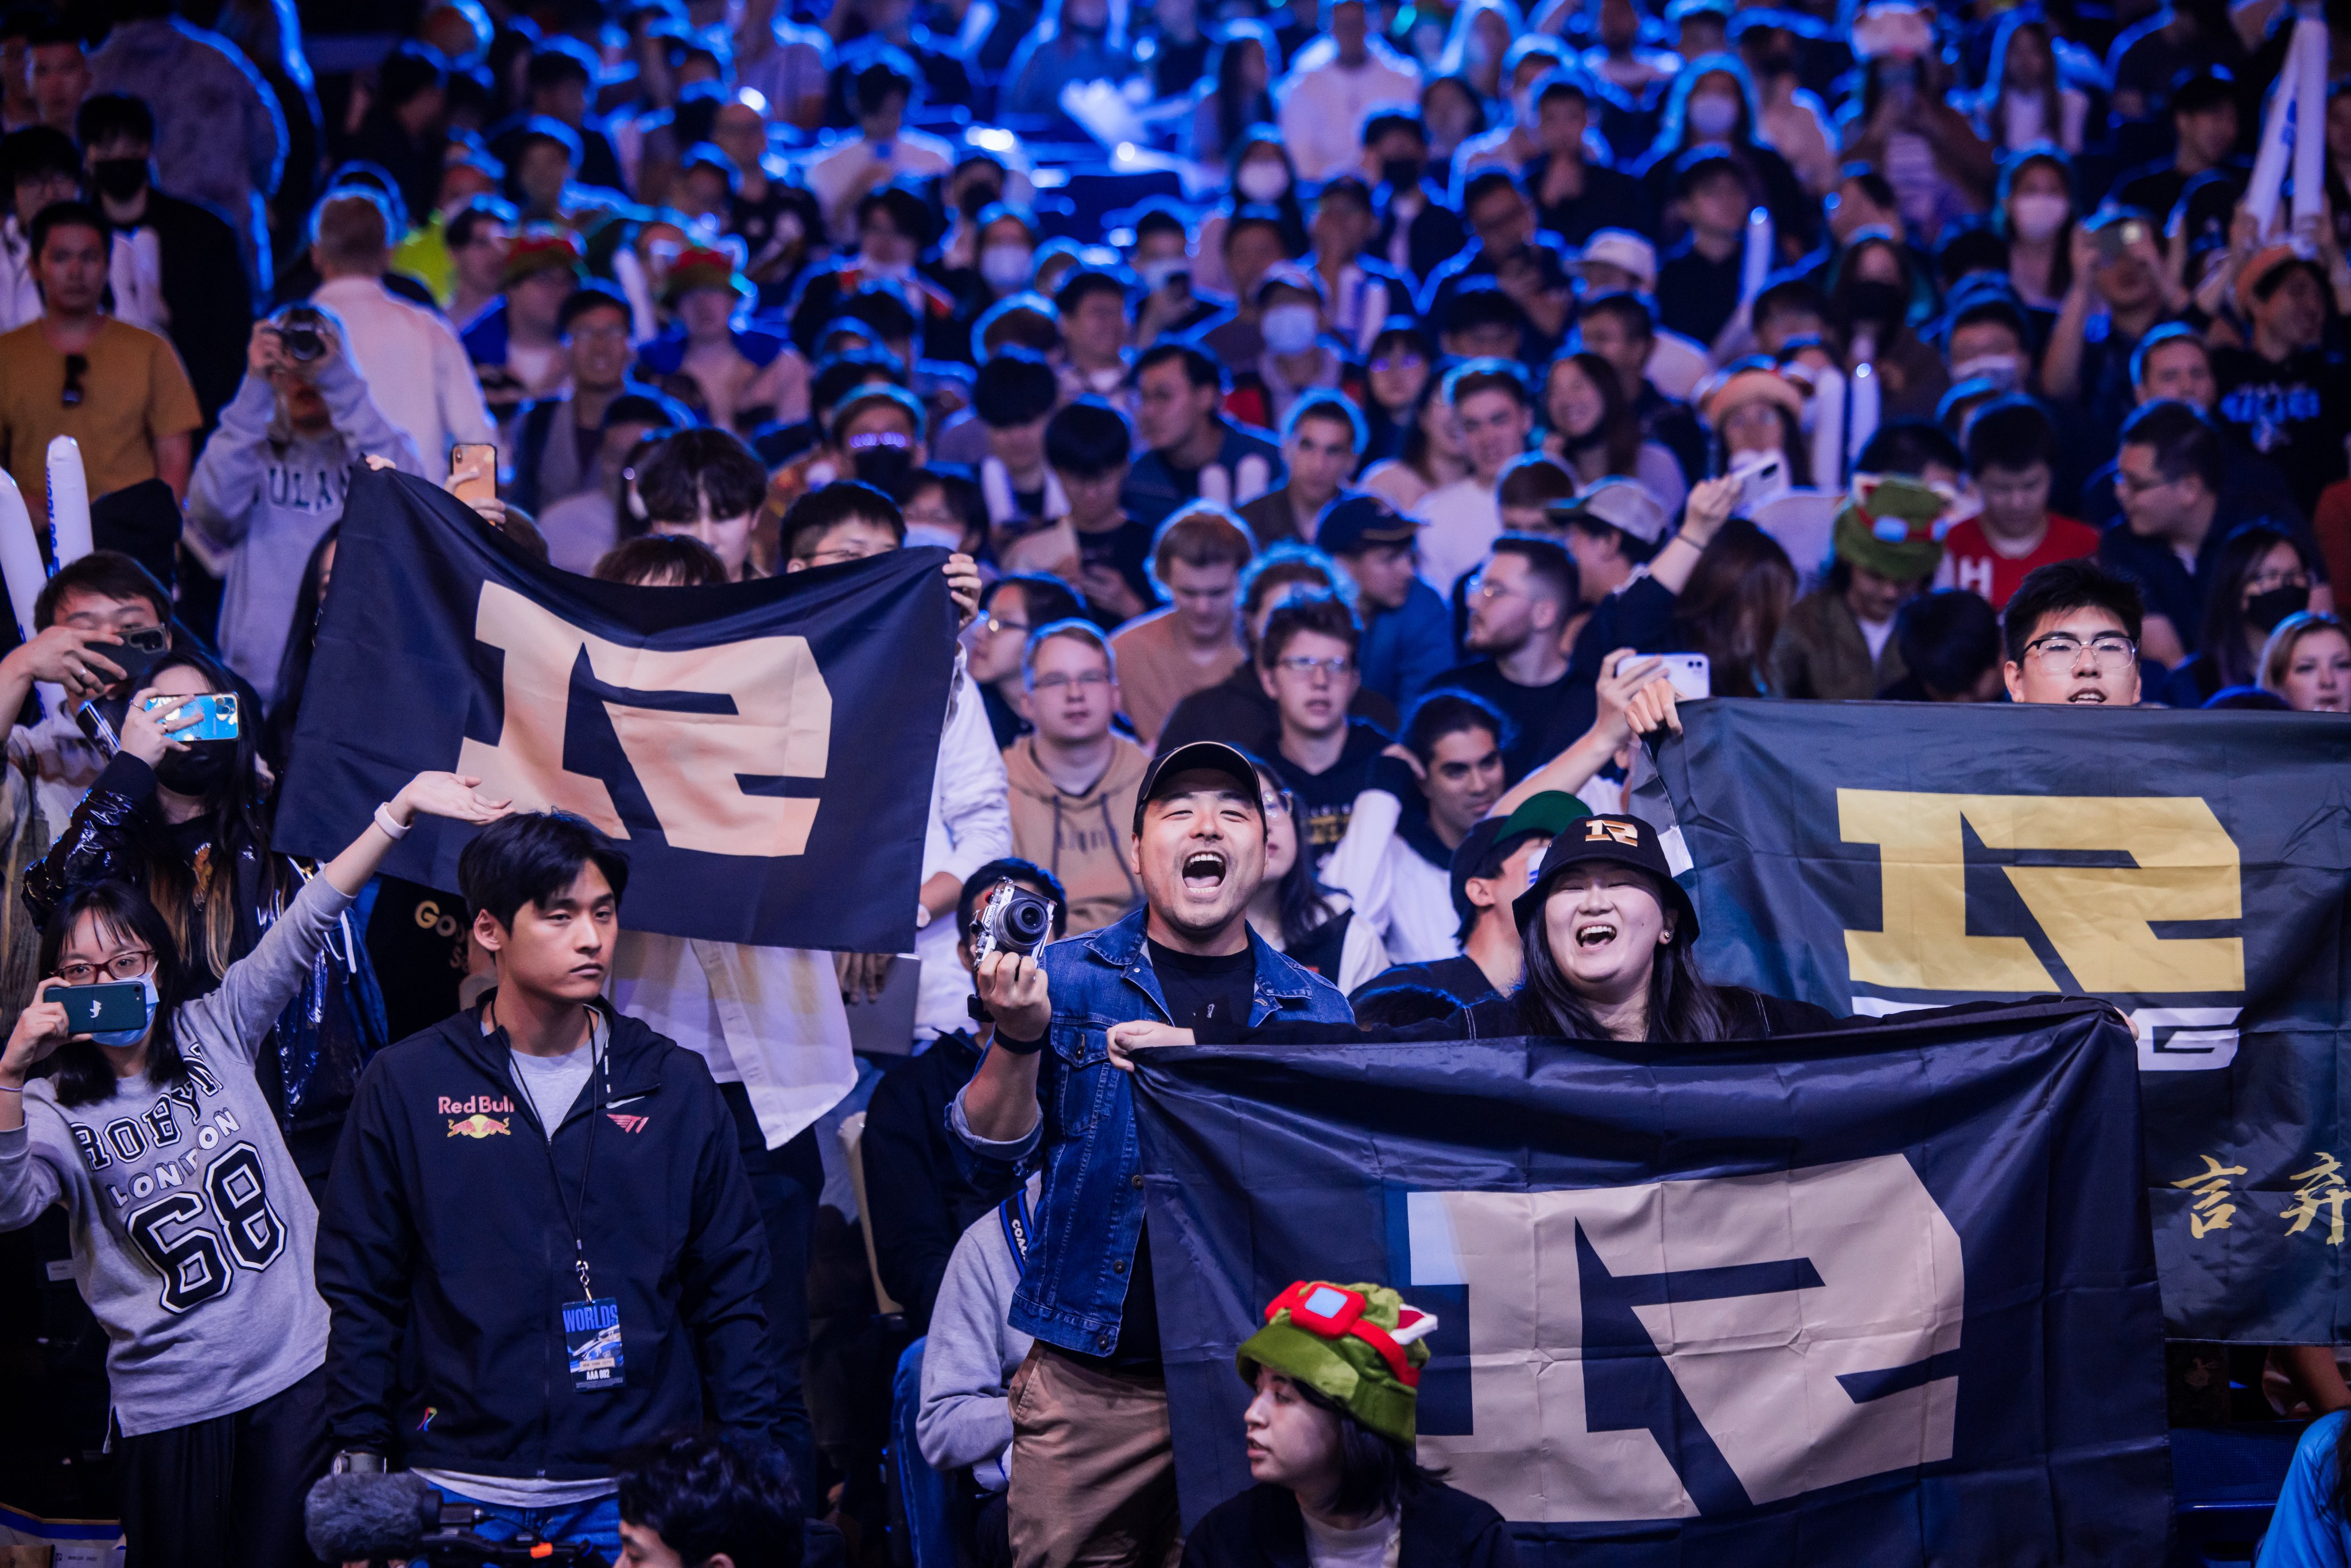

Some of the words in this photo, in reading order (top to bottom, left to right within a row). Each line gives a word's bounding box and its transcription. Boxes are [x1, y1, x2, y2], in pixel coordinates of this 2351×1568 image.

[986, 906, 996, 925] Nikon
[70, 1041, 224, 1171] ROBYN
[438, 1095, 476, 1114] Red
[106, 1107, 240, 1208] LONDON
[125, 1139, 288, 1316] 68
[1012, 1219, 1027, 1262] COAC
[562, 1304, 620, 1333] WORLDS
